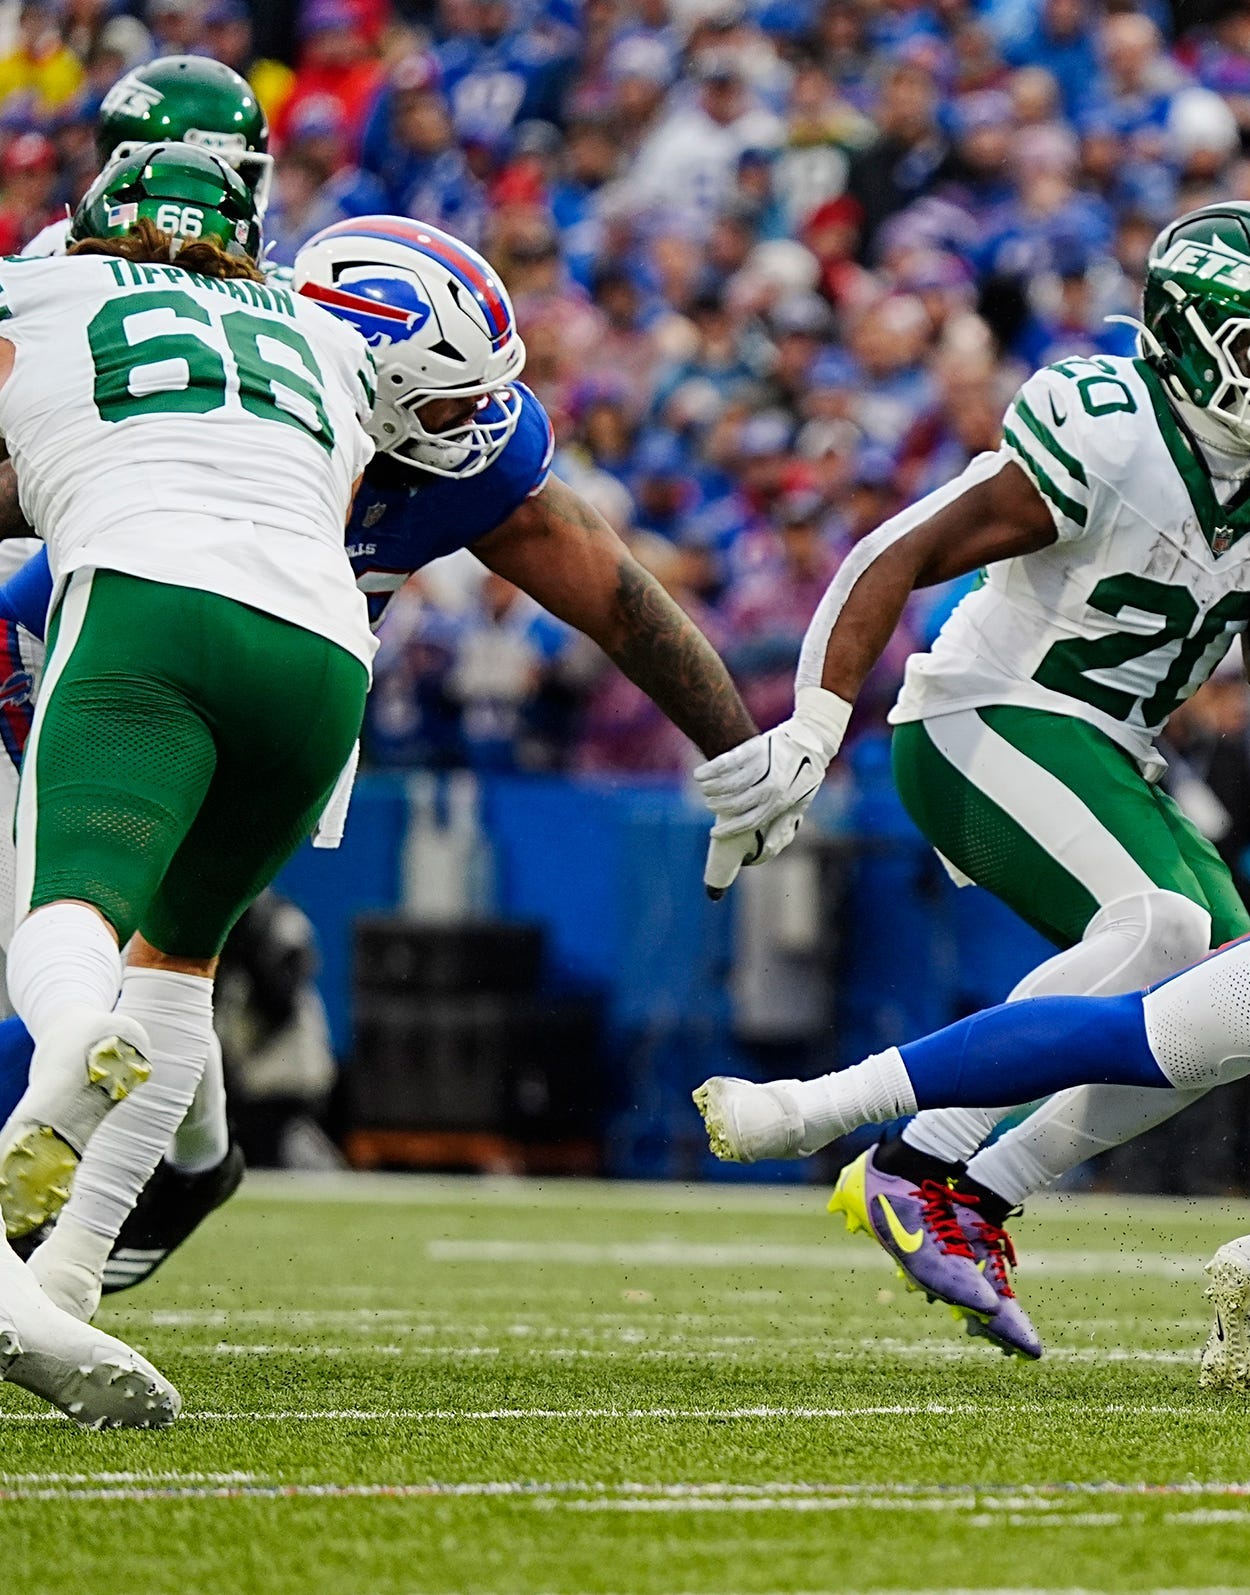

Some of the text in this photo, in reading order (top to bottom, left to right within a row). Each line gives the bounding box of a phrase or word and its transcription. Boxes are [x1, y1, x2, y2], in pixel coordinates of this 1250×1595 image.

[157, 204, 204, 238] 66
[103, 259, 295, 318] TIPPMANN
[87, 290, 334, 458] 66
[1047, 359, 1137, 417] 20
[345, 543, 377, 557] ILLS
